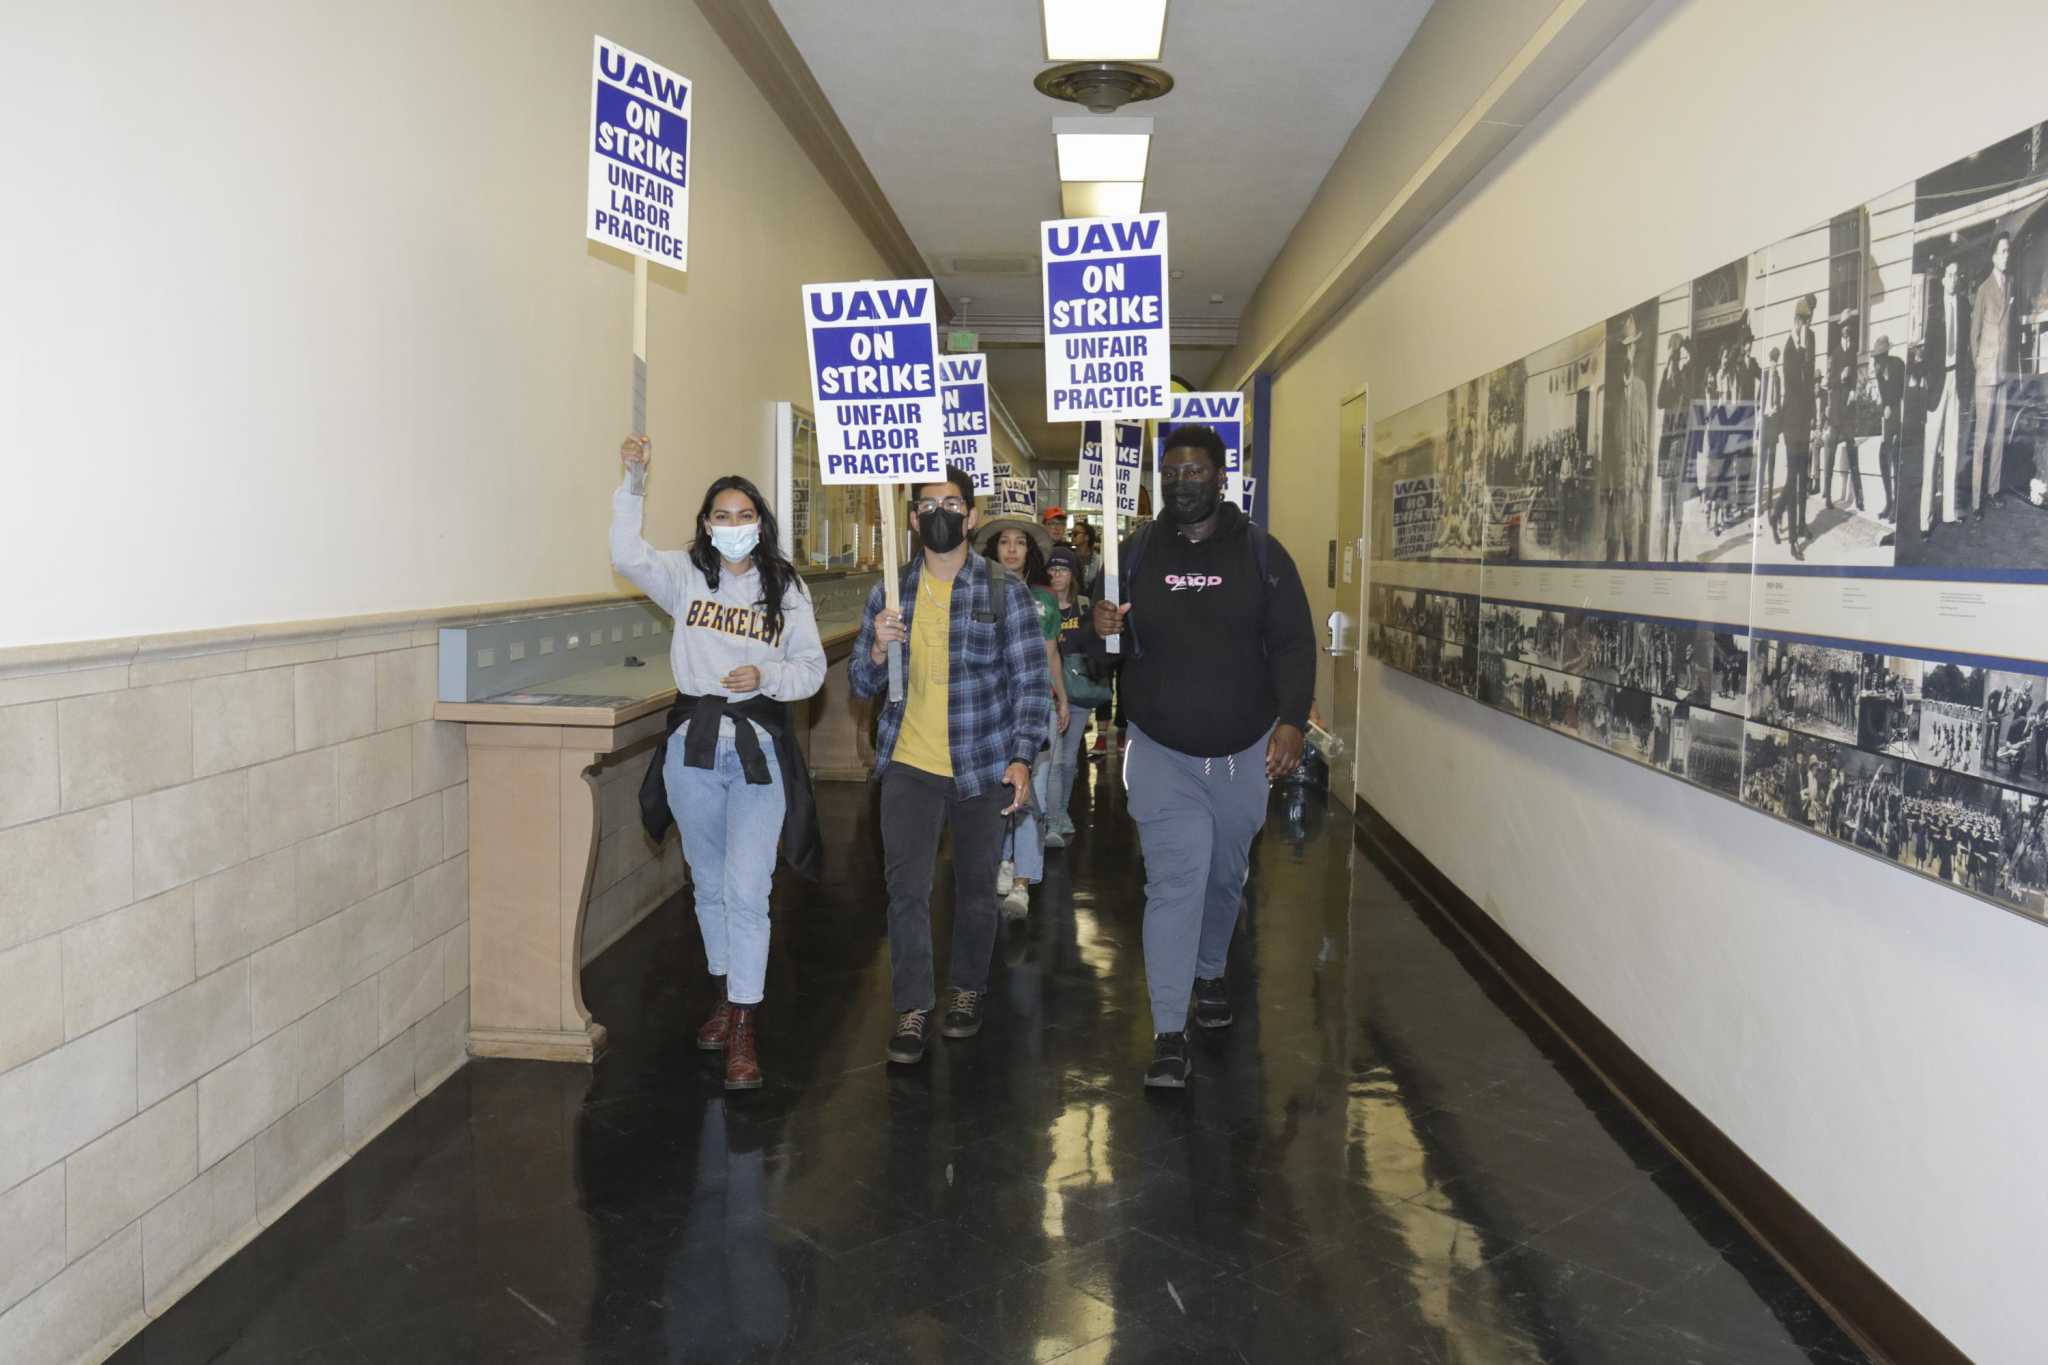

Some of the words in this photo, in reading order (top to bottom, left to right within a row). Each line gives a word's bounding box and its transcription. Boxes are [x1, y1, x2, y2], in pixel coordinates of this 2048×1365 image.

[599, 46, 688, 111] UAW
[626, 100, 661, 138] ON
[598, 121, 685, 181] STRIKE
[607, 163, 674, 208] UNFAIR
[610, 190, 670, 231] LABOR
[595, 209, 683, 261] PRACTICE
[1048, 220, 1160, 256] UAW
[1082, 263, 1125, 294] ON
[810, 288, 928, 322] UAW
[1052, 295, 1160, 328] STRIKE
[849, 331, 895, 361] ON
[1065, 335, 1148, 359] UNFAIR
[821, 363, 932, 394] STRIKE
[1070, 361, 1144, 385] LABOR
[943, 388, 960, 411] N
[1053, 385, 1163, 411] PRACTICE
[837, 403, 921, 426] UNFAIR
[843, 428, 919, 451] LABOR
[944, 438, 978, 456] FAIR
[1084, 441, 1138, 464] STKE
[828, 452, 940, 475] PRACTICE
[1089, 463, 1131, 482] UNIR
[1080, 489, 1136, 511] PRAICE
[1090, 477, 1128, 495] LAR
